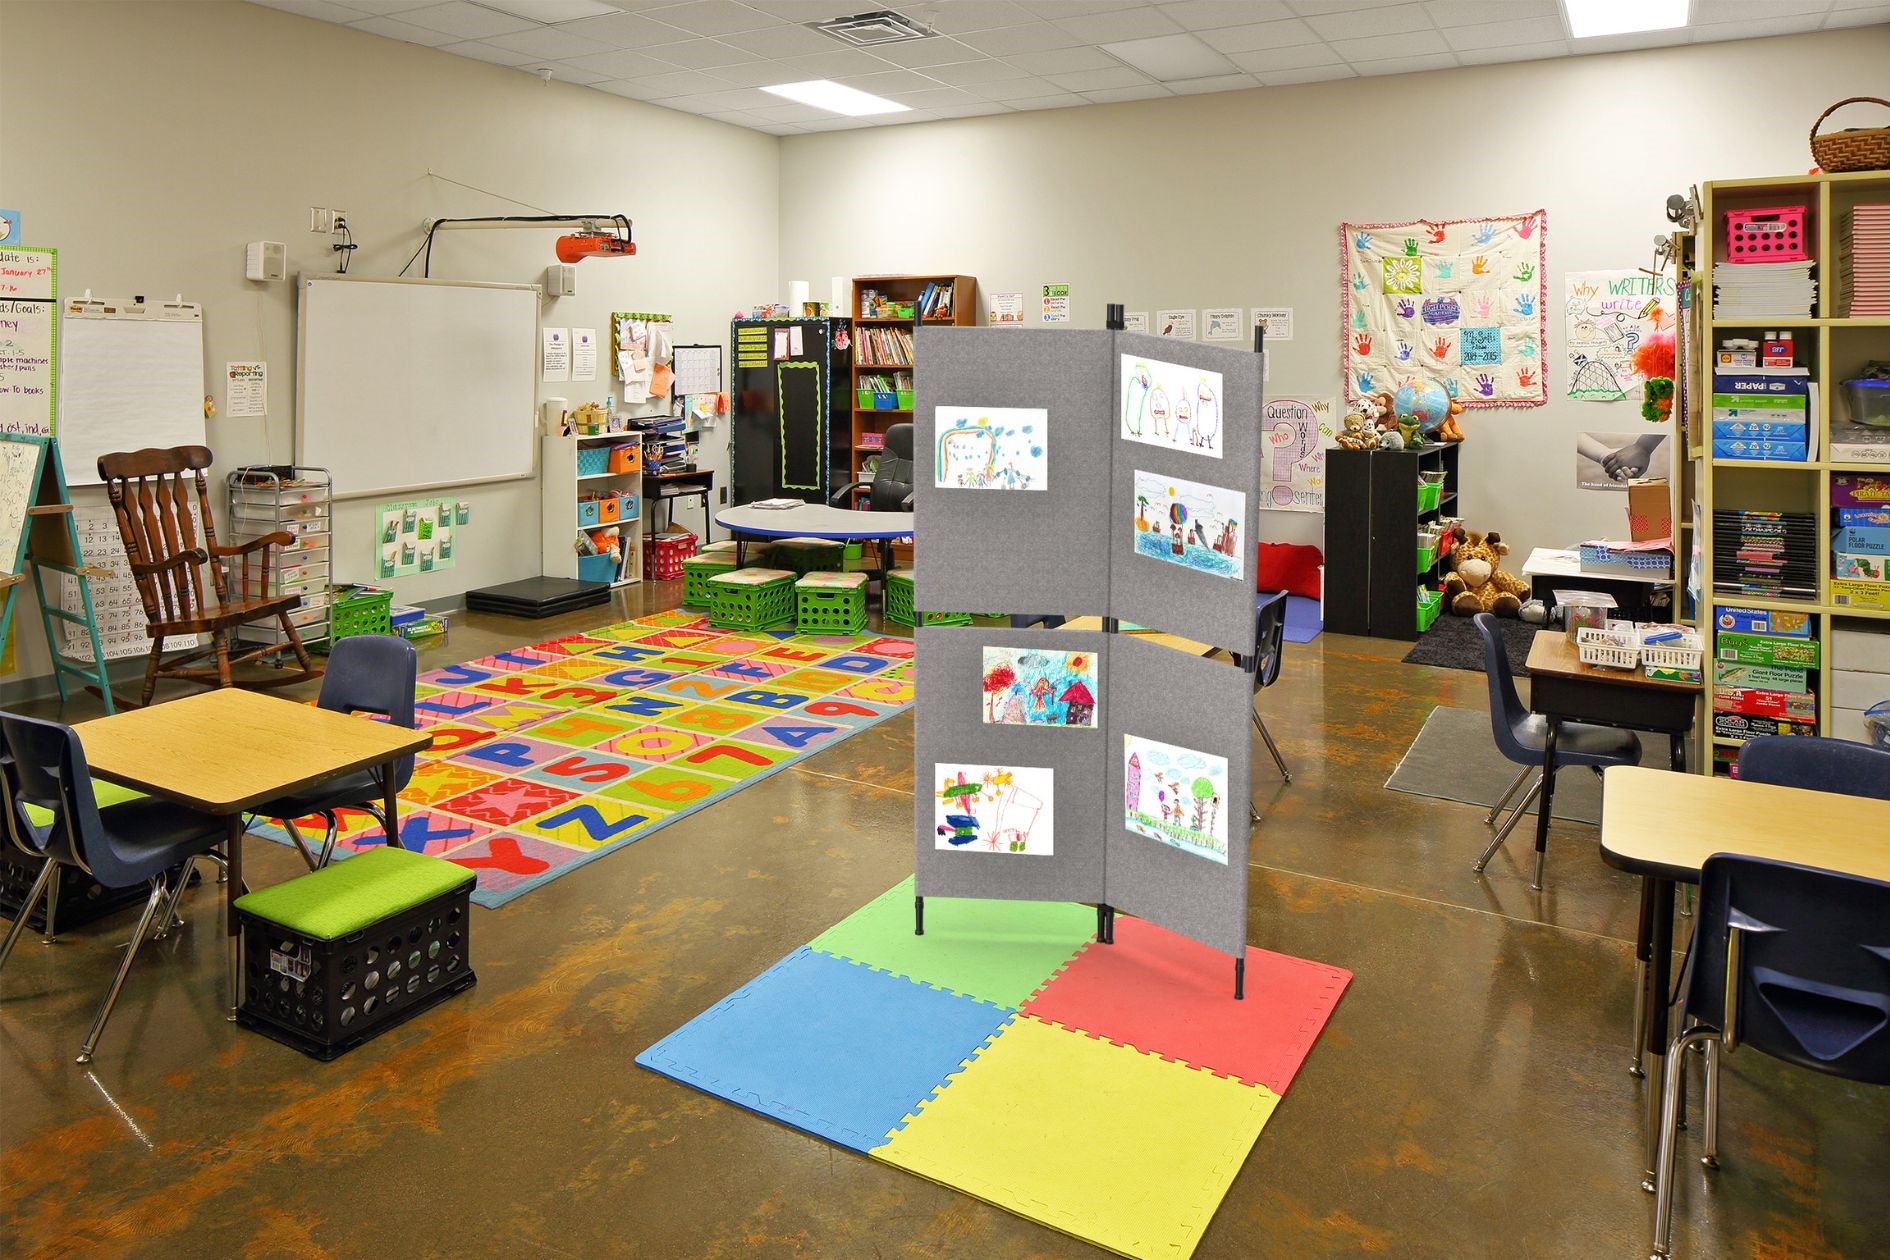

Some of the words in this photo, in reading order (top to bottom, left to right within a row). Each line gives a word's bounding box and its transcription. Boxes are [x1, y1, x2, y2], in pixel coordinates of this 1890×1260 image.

[1043, 285, 1050, 296] 3
[1573, 281, 1599, 303] Why
[1609, 277, 1676, 296] WRITERS
[1601, 299, 1642, 310] write
[1734, 382, 1764, 390] PAPER
[1267, 404, 1308, 419] Question
[1312, 401, 1330, 413] Why
[1269, 432, 1289, 445] Who
[1318, 422, 1334, 437] Can
[1299, 463, 1321, 473] Where
[593, 646, 665, 662] H
[762, 647, 829, 662] E
[716, 663, 772, 678] F
[817, 656, 889, 674] D
[435, 665, 492, 684] J
[605, 669, 672, 686] G
[778, 671, 850, 693] 10
[475, 678, 558, 695] K
[540, 687, 618, 704] 3
[667, 680, 741, 698] 2
[850, 682, 914, 701] C
[414, 701, 492, 715] L
[605, 696, 684, 716] N
[725, 690, 810, 708] B
[475, 705, 570, 730] M
[803, 701, 879, 717] 9
[536, 717, 625, 738] 4
[676, 709, 754, 730] 8
[762, 726, 838, 748] A
[466, 743, 535, 768] P
[686, 745, 774, 766] 7
[626, 780, 713, 801] 6
[535, 804, 649, 841] Z
[352, 817, 475, 854] X
[447, 838, 550, 875] Y
